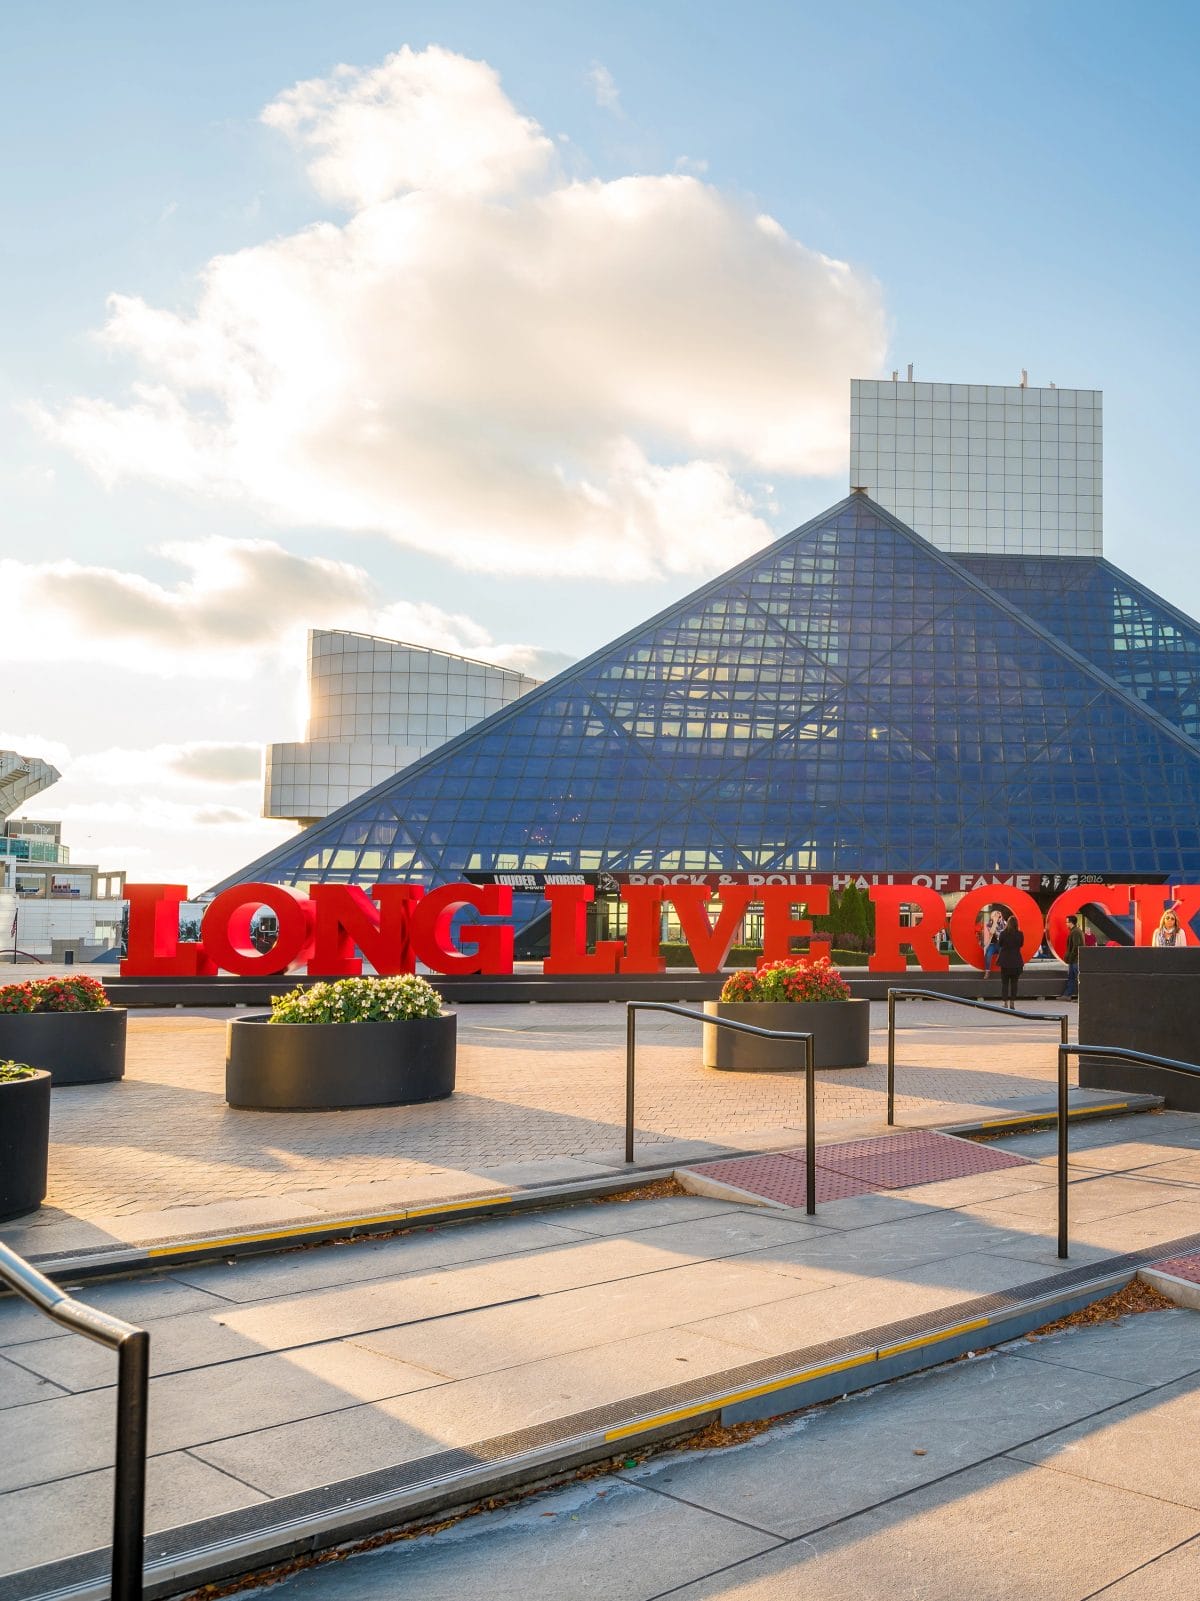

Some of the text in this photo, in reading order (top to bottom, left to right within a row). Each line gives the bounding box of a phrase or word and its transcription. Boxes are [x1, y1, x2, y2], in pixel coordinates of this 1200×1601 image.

[543, 874, 586, 885] WORDS
[911, 874, 949, 890] OF
[959, 874, 1031, 890] FAME
[1079, 874, 1104, 883] 2016
[119, 882, 516, 976] LONG
[543, 883, 830, 975] LIVE
